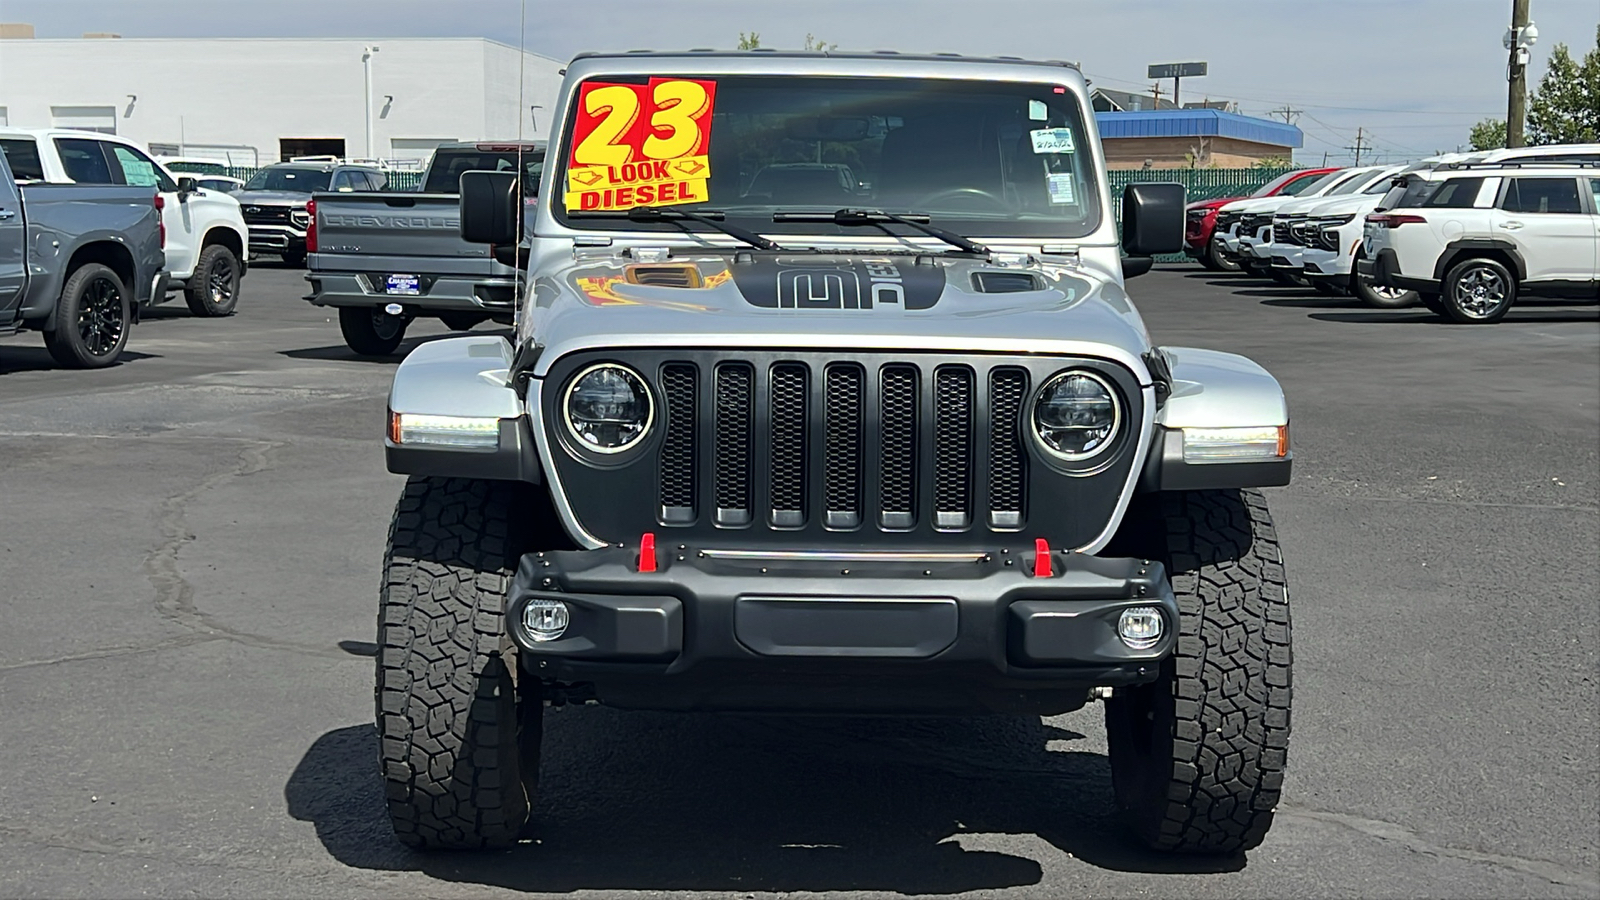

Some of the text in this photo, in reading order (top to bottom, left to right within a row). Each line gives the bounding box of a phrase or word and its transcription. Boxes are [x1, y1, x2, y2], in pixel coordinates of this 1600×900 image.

[575, 81, 710, 166] 23
[608, 160, 673, 185] LOOK
[580, 181, 697, 210] DIESEL
[324, 215, 461, 229] CHEVROLE
